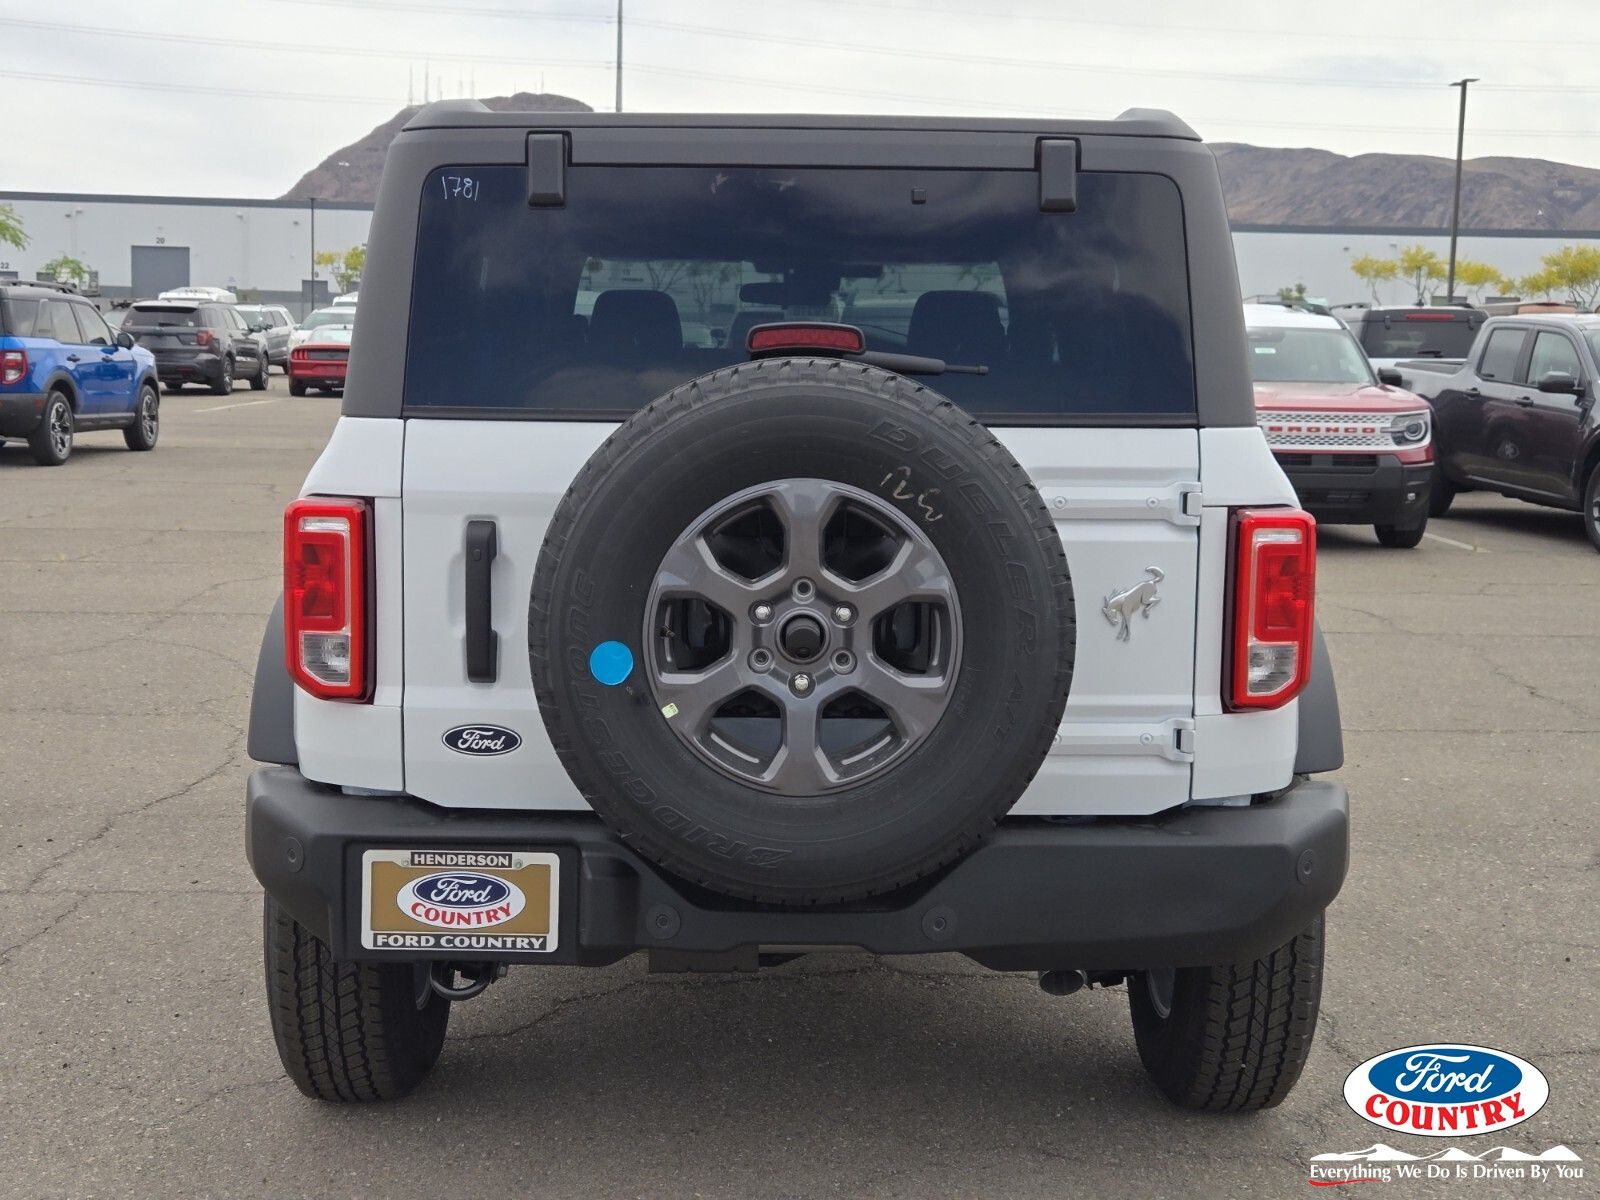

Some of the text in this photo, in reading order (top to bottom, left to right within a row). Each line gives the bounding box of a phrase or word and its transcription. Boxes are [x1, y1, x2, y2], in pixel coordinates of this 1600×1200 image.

[441, 175, 480, 202] 1781
[156, 237, 166, 245] 20
[1268, 425, 1376, 434] BRONCO
[868, 418, 1041, 656] DUELER
[566, 567, 793, 869] BRIDGESTONE
[457, 729, 506, 750] Ford
[413, 853, 510, 868] HENDERSON
[430, 876, 493, 904] Ford
[410, 901, 512, 926] COUNTRY
[376, 934, 545, 950] FORD COUNTRY
